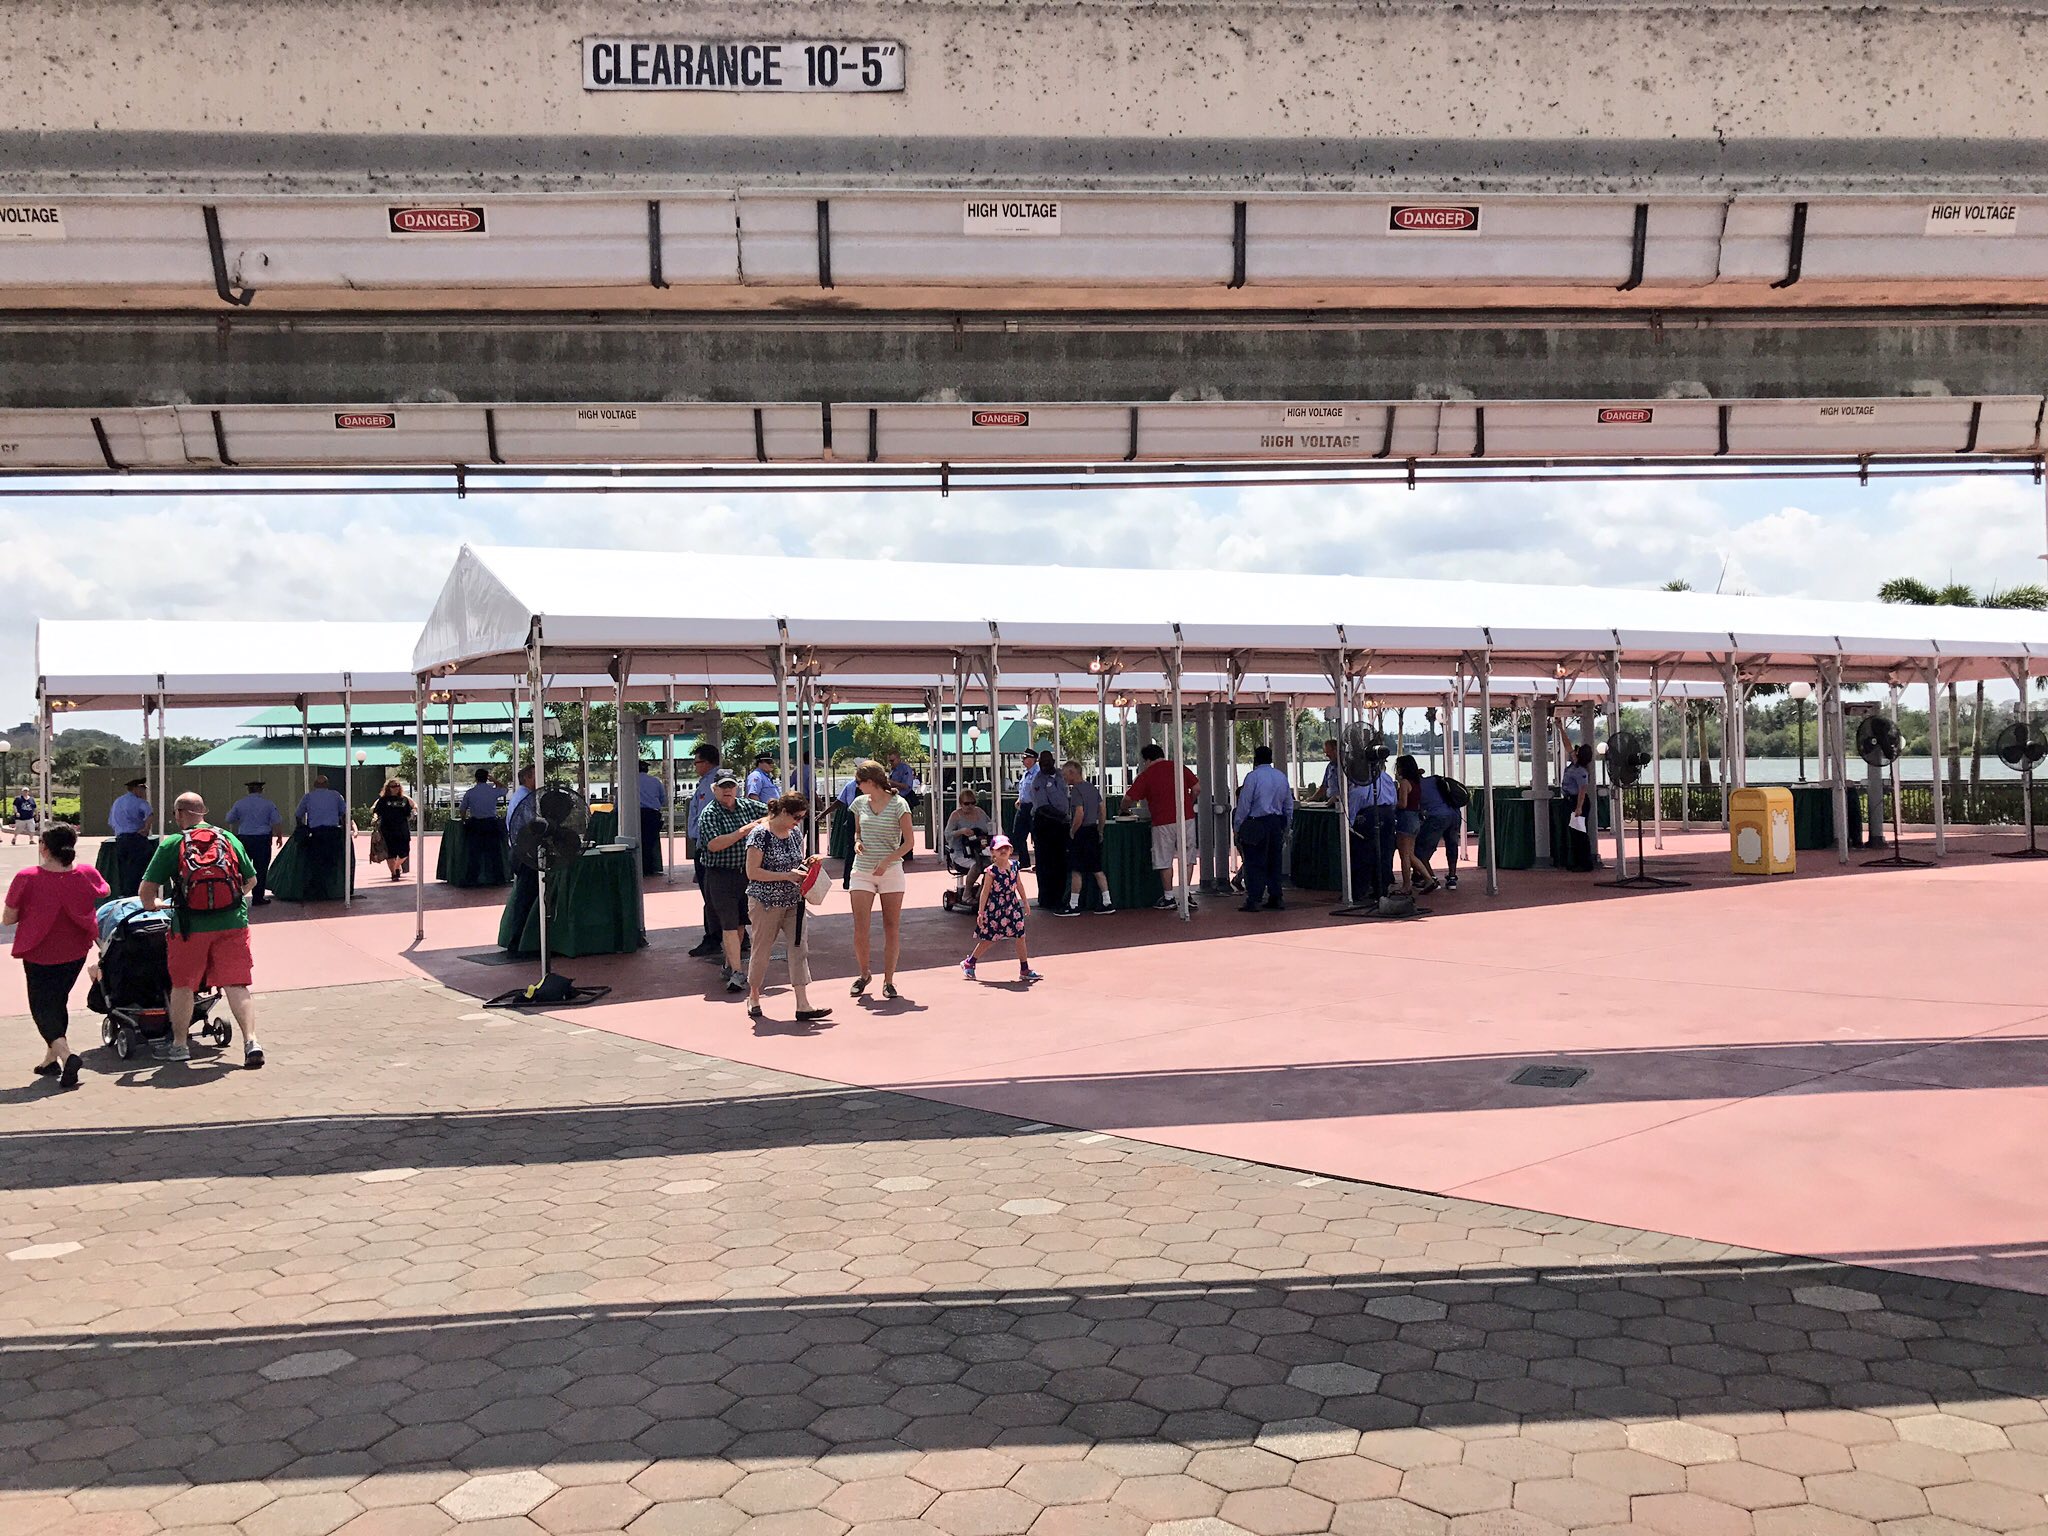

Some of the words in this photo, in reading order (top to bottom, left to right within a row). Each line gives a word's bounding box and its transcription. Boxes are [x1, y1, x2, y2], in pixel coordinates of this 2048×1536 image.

[592, 43, 783, 86] CLEARANCE
[967, 203, 998, 218] HIGH
[1002, 203, 1057, 218] VOLTAGE
[1931, 205, 1961, 220] HIGH
[1965, 205, 2016, 220] VOLTAGE
[404, 213, 470, 227] DANGER
[1403, 212, 1465, 225] DANGER
[578, 409, 598, 419] HIGH
[600, 409, 637, 419] VOLTAGE
[1287, 408, 1306, 417] HIGH
[1308, 407, 1343, 417] VOLTAGE
[1606, 411, 1644, 420] DANGER
[1820, 406, 1839, 416] HIGH
[1841, 406, 1874, 416] VOLTAGE
[344, 416, 386, 426] DANGER
[980, 414, 1020, 423] DANGER
[1261, 435, 1294, 448] HIGH
[1300, 435, 1360, 448] VOLTAGE
